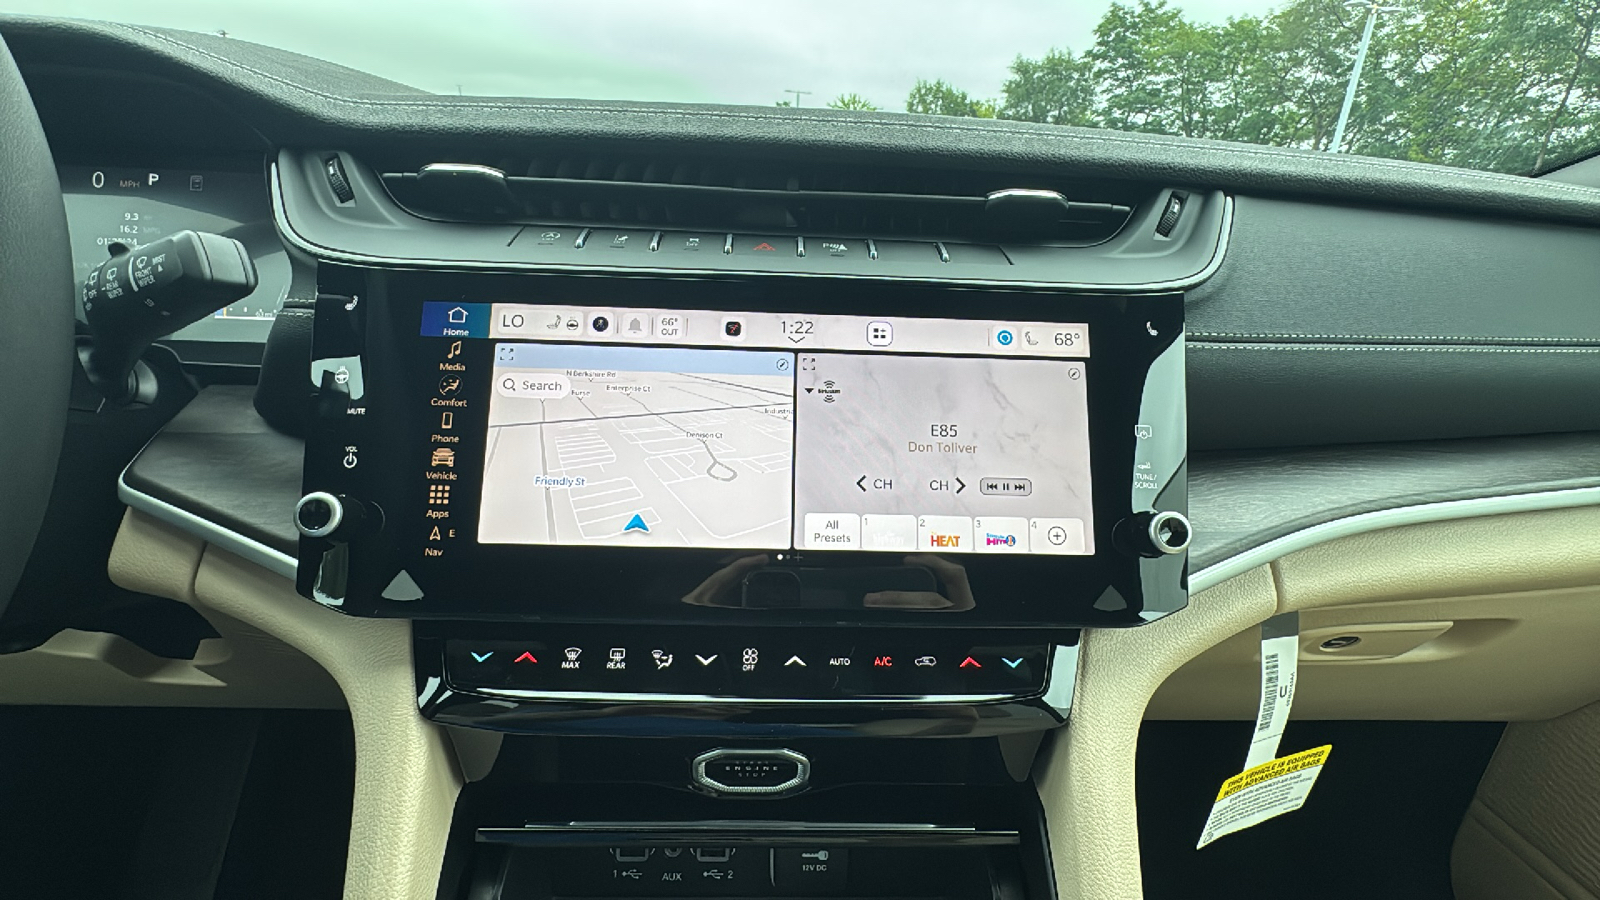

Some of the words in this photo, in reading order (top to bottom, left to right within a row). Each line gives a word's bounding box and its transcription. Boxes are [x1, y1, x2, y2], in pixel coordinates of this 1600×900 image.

[119, 180, 140, 188] MPH
[148, 173, 159, 185] P
[124, 212, 139, 221] 9.3
[119, 225, 138, 234] 16.2
[152, 253, 166, 265] MIST
[134, 266, 152, 280] FRONT
[137, 275, 155, 288] WIPER
[502, 314, 524, 328] LO
[443, 328, 469, 336] Home
[661, 327, 679, 336] OUT
[780, 320, 814, 335] 1:22
[1054, 332, 1080, 347] 68°
[439, 362, 466, 371] Media
[522, 380, 562, 391] Search
[606, 384, 642, 392] Enterprise
[430, 398, 468, 407] Comfort
[686, 431, 713, 439] Denison
[930, 424, 958, 437] E85
[431, 434, 460, 443] Phone
[908, 441, 933, 452] Don
[936, 442, 978, 454] Toliver
[425, 471, 458, 481] Vehicle
[534, 475, 575, 487] Friendly
[575, 477, 585, 486] St
[1135, 473, 1157, 481] TUNE/
[873, 478, 893, 490] CH
[929, 479, 949, 491] CH
[426, 509, 449, 519] Apps
[824, 520, 839, 530] All
[919, 518, 926, 527] 2
[975, 519, 982, 528] 3
[1031, 521, 1037, 529] 4
[449, 529, 455, 537] E
[813, 532, 851, 543] Presets
[930, 534, 961, 547] HEAT
[424, 548, 444, 556] Nav
[561, 661, 580, 669] MAX
[606, 661, 626, 669] REAR
[829, 656, 850, 666] AUTO
[874, 656, 892, 667] A/C
[1245, 764, 1277, 780] VEHICLE
[1286, 750, 1325, 766] EQUIPPED
[1223, 784, 1243, 797] WITH
[1243, 768, 1286, 787] ADVANCED
[1285, 765, 1299, 773] AIR
[1299, 758, 1321, 769] BAGS
[612, 869, 618, 878] 1
[661, 872, 682, 881] AUX
[727, 870, 734, 879] 2
